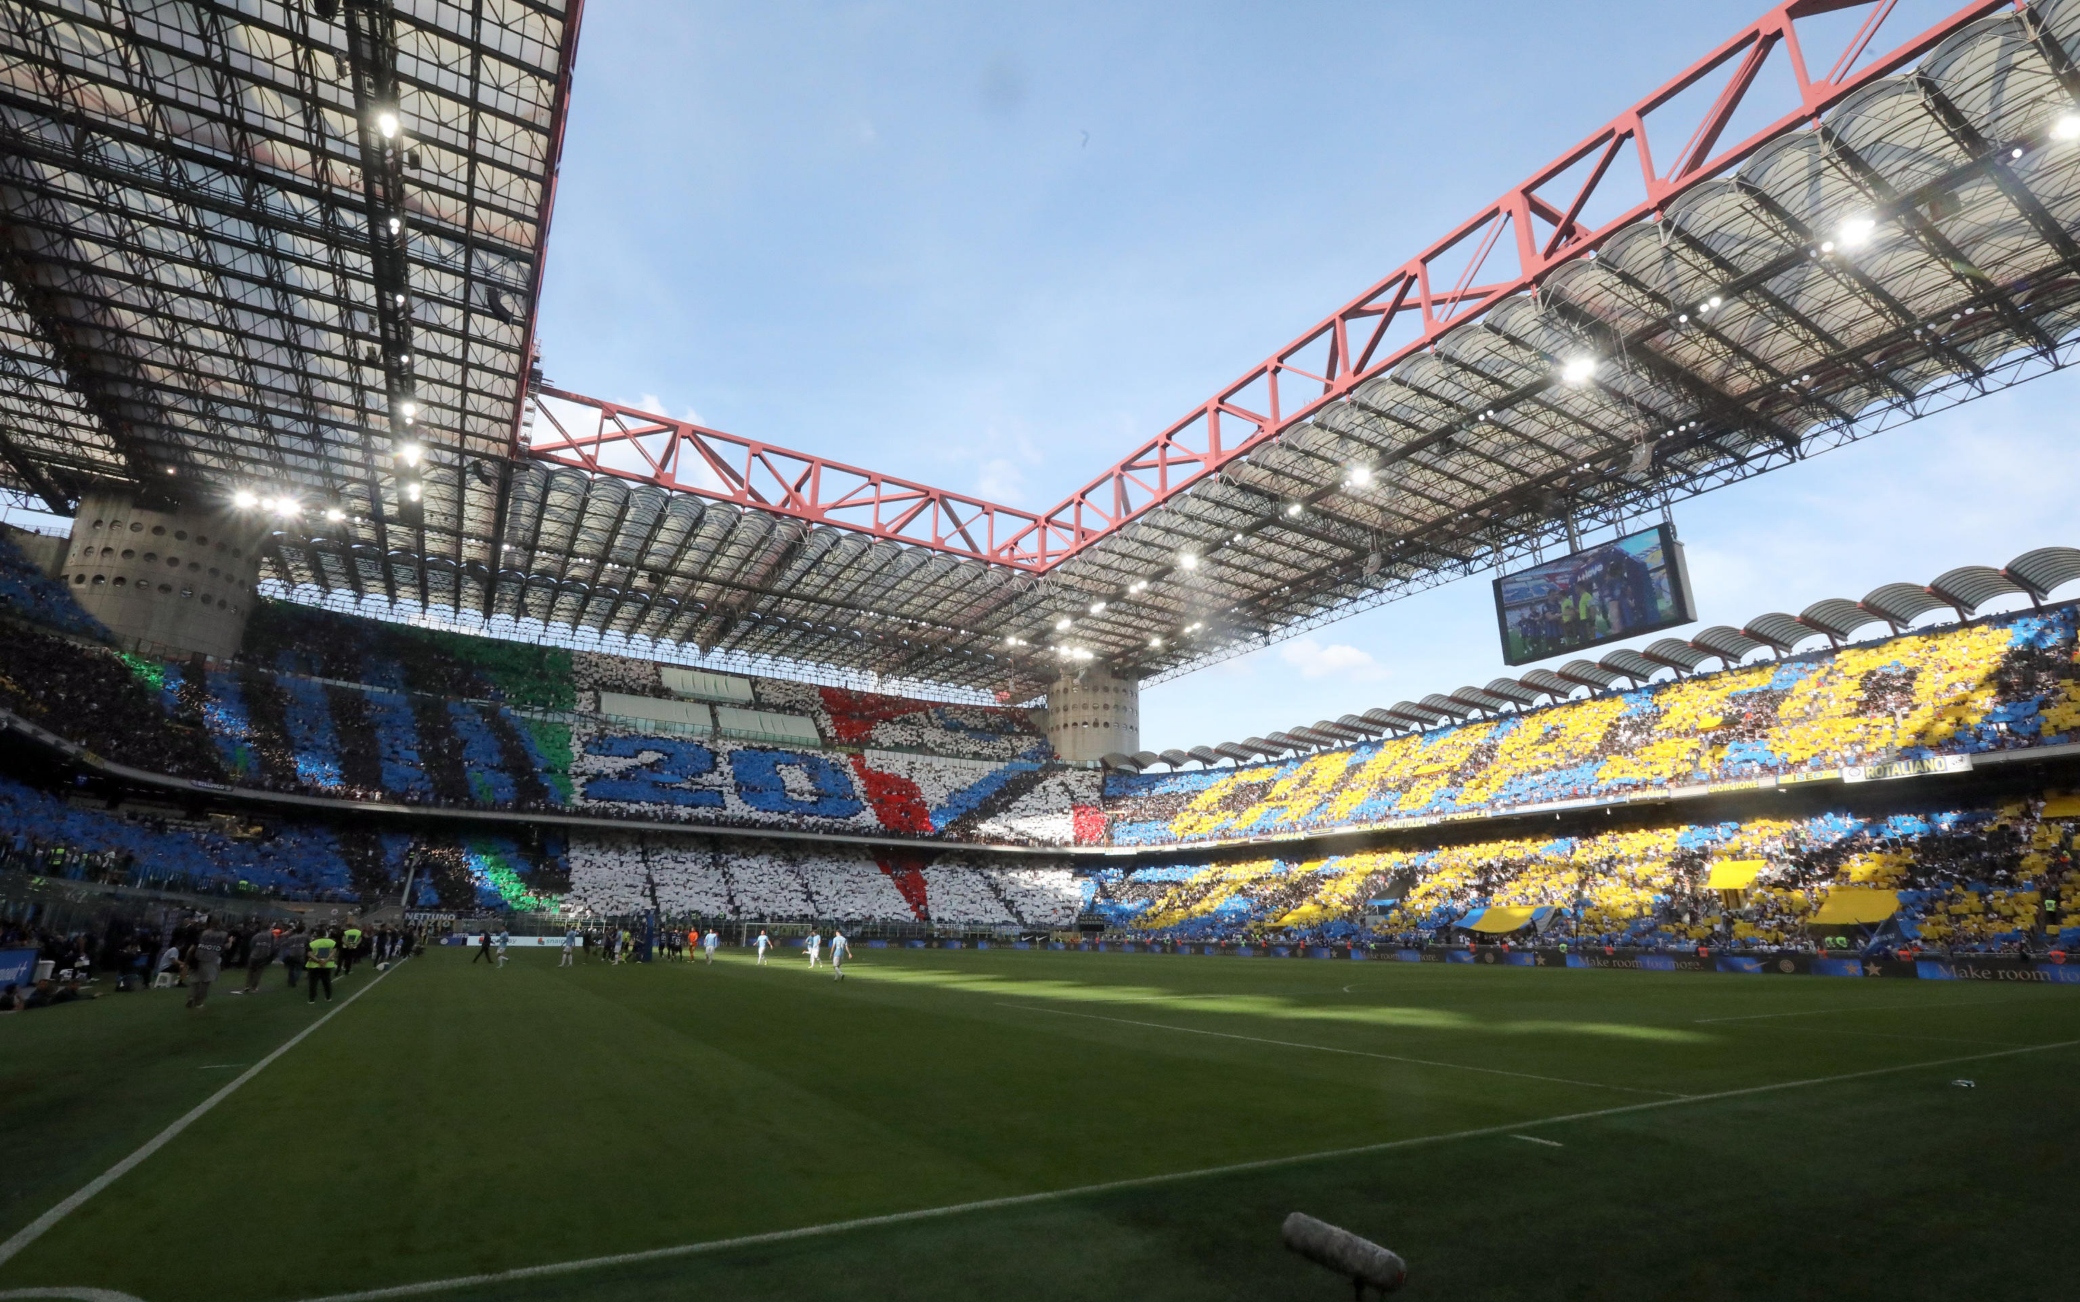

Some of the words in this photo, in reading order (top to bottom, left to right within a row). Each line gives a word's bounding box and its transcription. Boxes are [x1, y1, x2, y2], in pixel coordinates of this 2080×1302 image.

[1865, 757, 1946, 779] ROTALIANO
[583, 735, 864, 818] 20
[1793, 772, 1823, 782] ISEO
[1707, 780, 1759, 793] GIORGIONE
[405, 912, 456, 921] NETTUNO
[197, 943, 222, 952] PHOTO
[1577, 956, 1609, 967] Make
[1612, 958, 1643, 969] room
[1937, 964, 1992, 979] Make
[1998, 968, 2052, 981] room
[2057, 967, 2080, 982] fo
